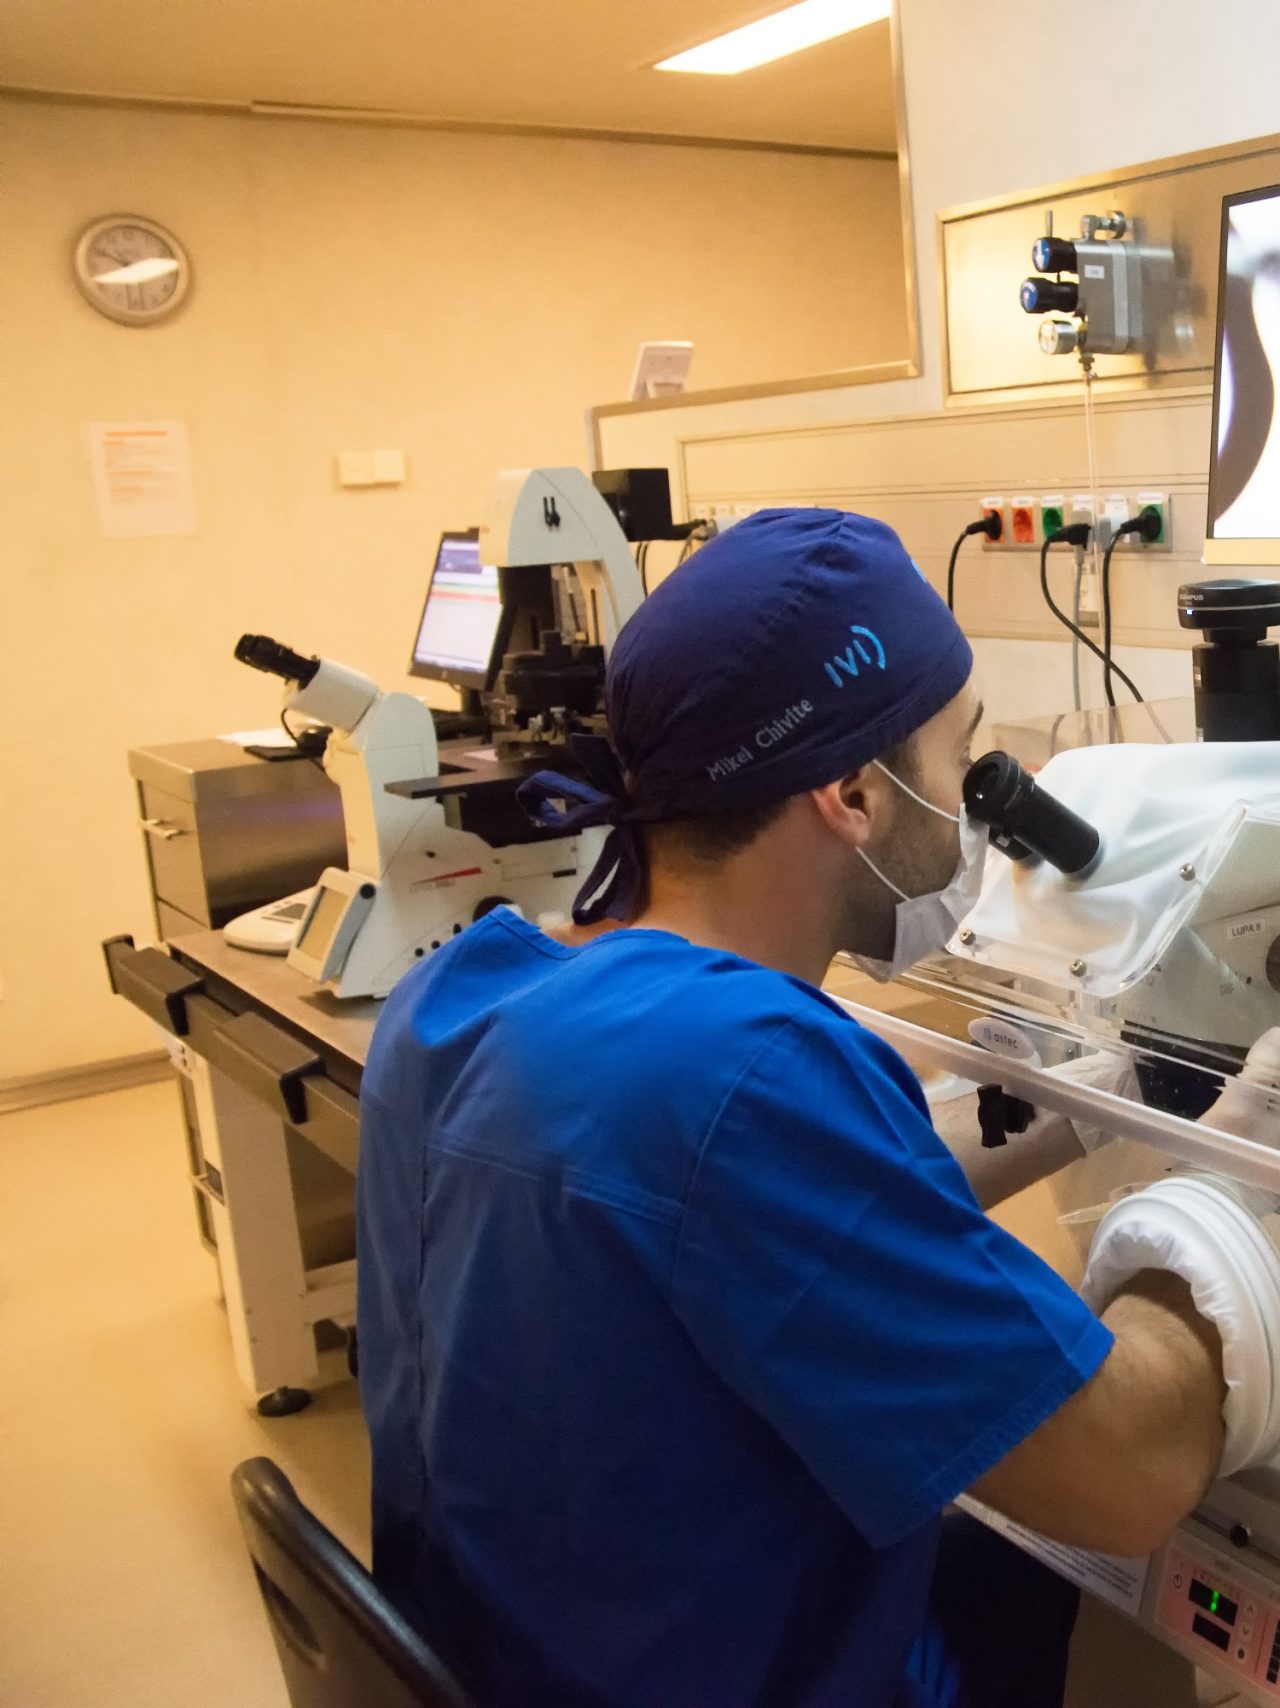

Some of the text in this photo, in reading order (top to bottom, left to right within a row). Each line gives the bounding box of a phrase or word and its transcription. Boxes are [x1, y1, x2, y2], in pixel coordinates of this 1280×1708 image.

[706, 697, 814, 782] Mikel Chivite
[1231, 923, 1255, 937] LUPA
